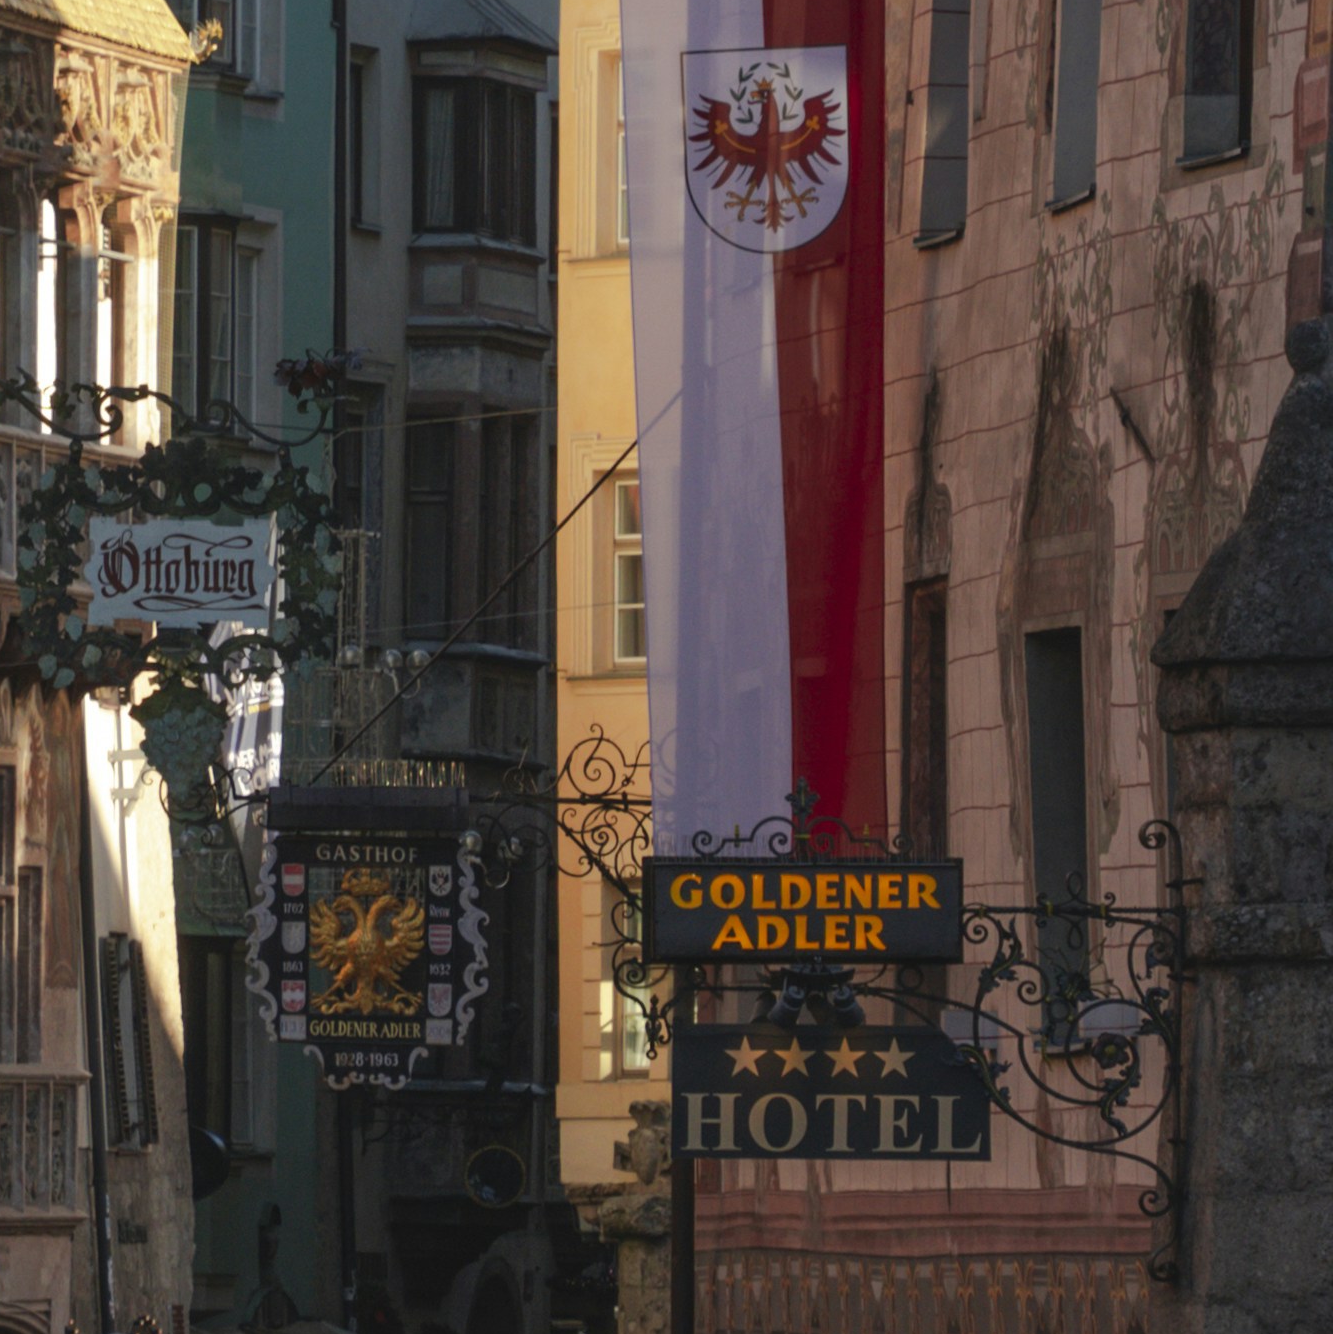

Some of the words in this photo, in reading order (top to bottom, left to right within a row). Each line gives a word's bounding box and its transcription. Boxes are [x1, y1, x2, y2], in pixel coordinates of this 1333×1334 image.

[98, 529, 259, 600] Ottoburg
[315, 843, 419, 864] GASTHOF
[669, 872, 942, 911] GOLDENER
[711, 914, 888, 952] ADLER
[309, 1019, 379, 1038] GOLDENER
[380, 1021, 422, 1039] ADLER
[679, 1092, 984, 1154] HOTEL
